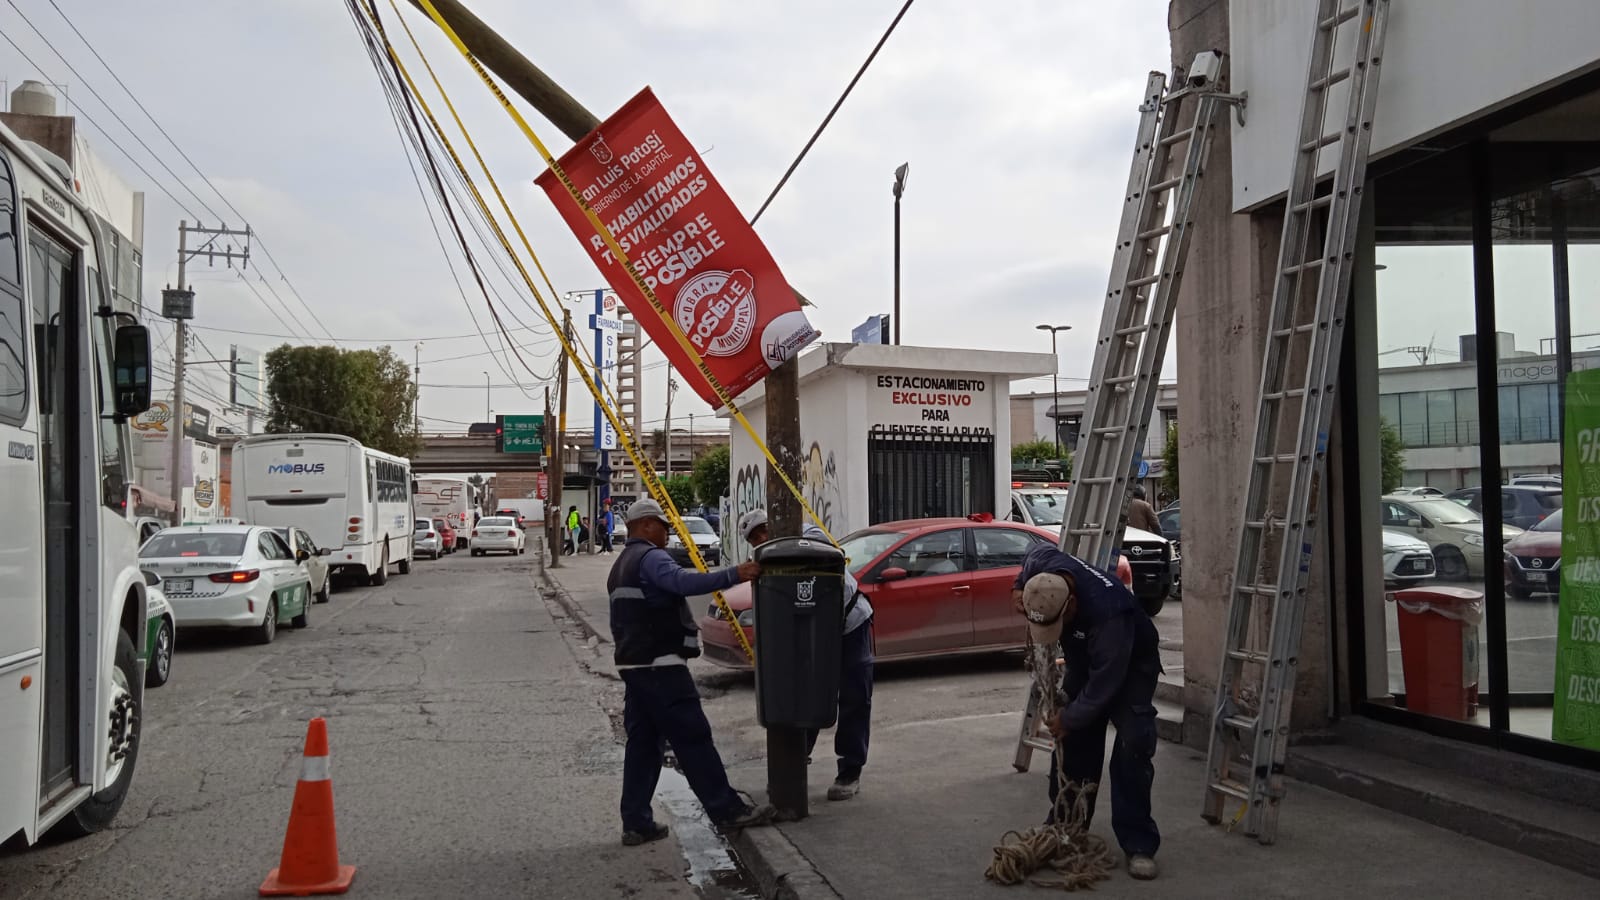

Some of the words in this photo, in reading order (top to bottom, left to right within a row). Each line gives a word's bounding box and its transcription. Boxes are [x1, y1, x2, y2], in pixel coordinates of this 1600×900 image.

[582, 185, 601, 201] an
[596, 165, 625, 190] Luis
[589, 187, 622, 217] OBIERNO
[620, 179, 634, 195] DE
[630, 172, 643, 186] LA
[641, 149, 673, 177] CAPITAL
[590, 156, 697, 252] RHABILITAMOS
[601, 236, 632, 267] TS
[628, 173, 708, 246] VIALIDADES
[683, 282, 709, 313] OBRA
[597, 317, 622, 331] FARMACIAS
[690, 280, 746, 349] POSÍBLE
[716, 303, 750, 349] MUNICIPAL
[877, 376, 985, 391] ESTACIONAMIENTO
[892, 391, 971, 406] EXCLUSIVO
[873, 424, 927, 436] CLIENTES
[931, 426, 944, 436] DE
[946, 427, 959, 437] LA
[962, 427, 991, 437] PLAZA
[922, 409, 950, 421] PARA
[268, 464, 325, 474] MOBUS
